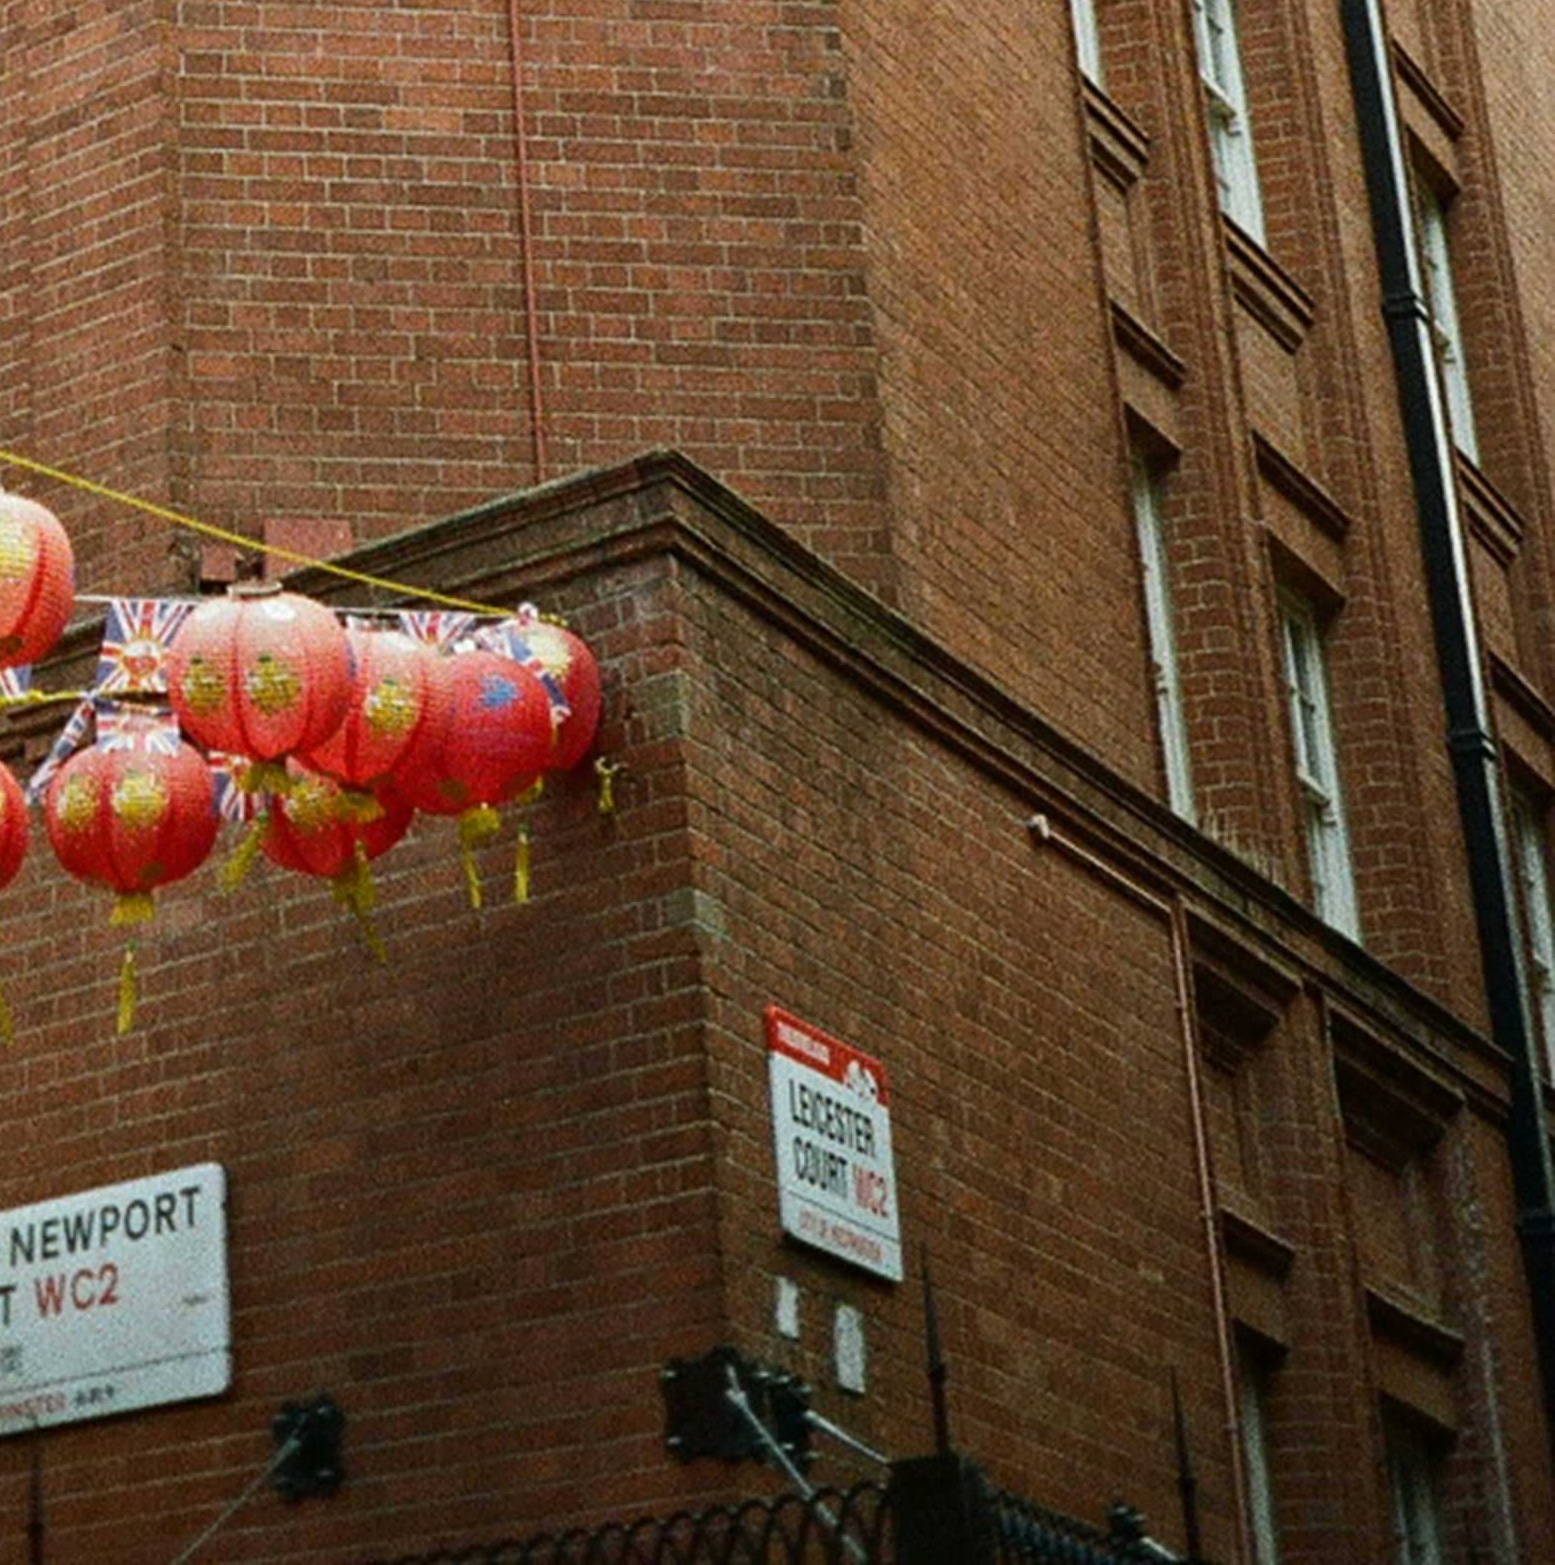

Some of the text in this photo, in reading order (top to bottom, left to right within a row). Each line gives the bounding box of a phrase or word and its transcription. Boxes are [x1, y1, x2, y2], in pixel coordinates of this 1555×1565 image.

[789, 1078, 877, 1159] LEICESTER
[793, 1135, 889, 1218] COURT WC2
[9, 1185, 203, 1269] NEWPORT
[33, 1262, 120, 1320] WC2
